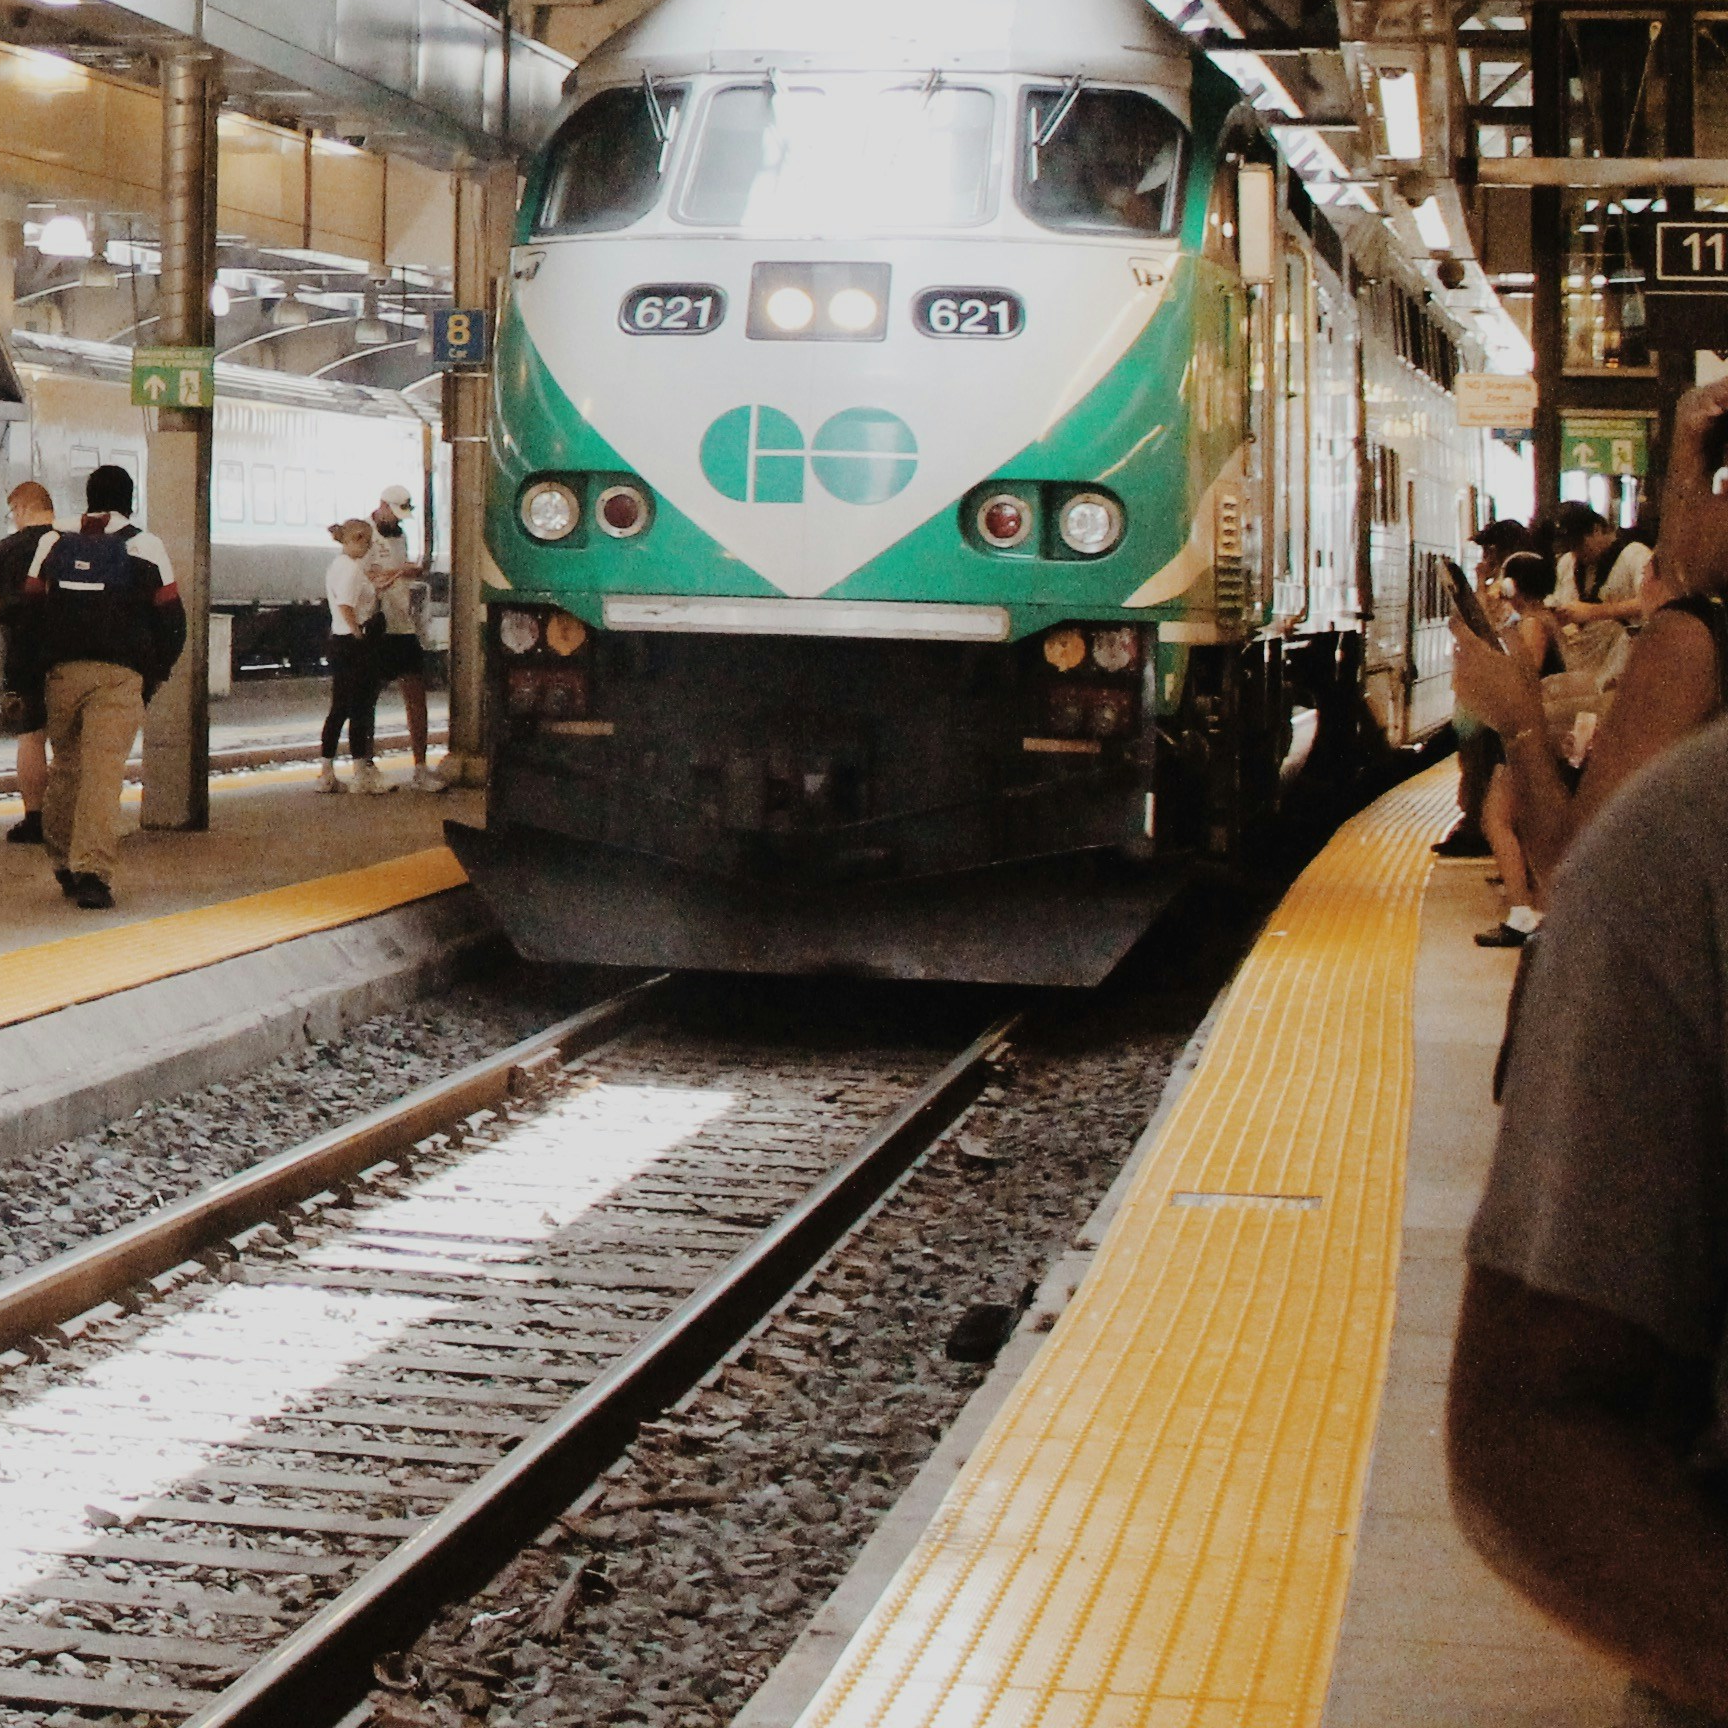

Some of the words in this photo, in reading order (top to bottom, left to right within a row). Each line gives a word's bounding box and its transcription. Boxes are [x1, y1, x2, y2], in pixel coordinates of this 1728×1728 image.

[1682, 232, 1724, 271] 11
[447, 313, 471, 346] 8
[634, 295, 714, 329] 621
[929, 298, 1013, 334] 621
